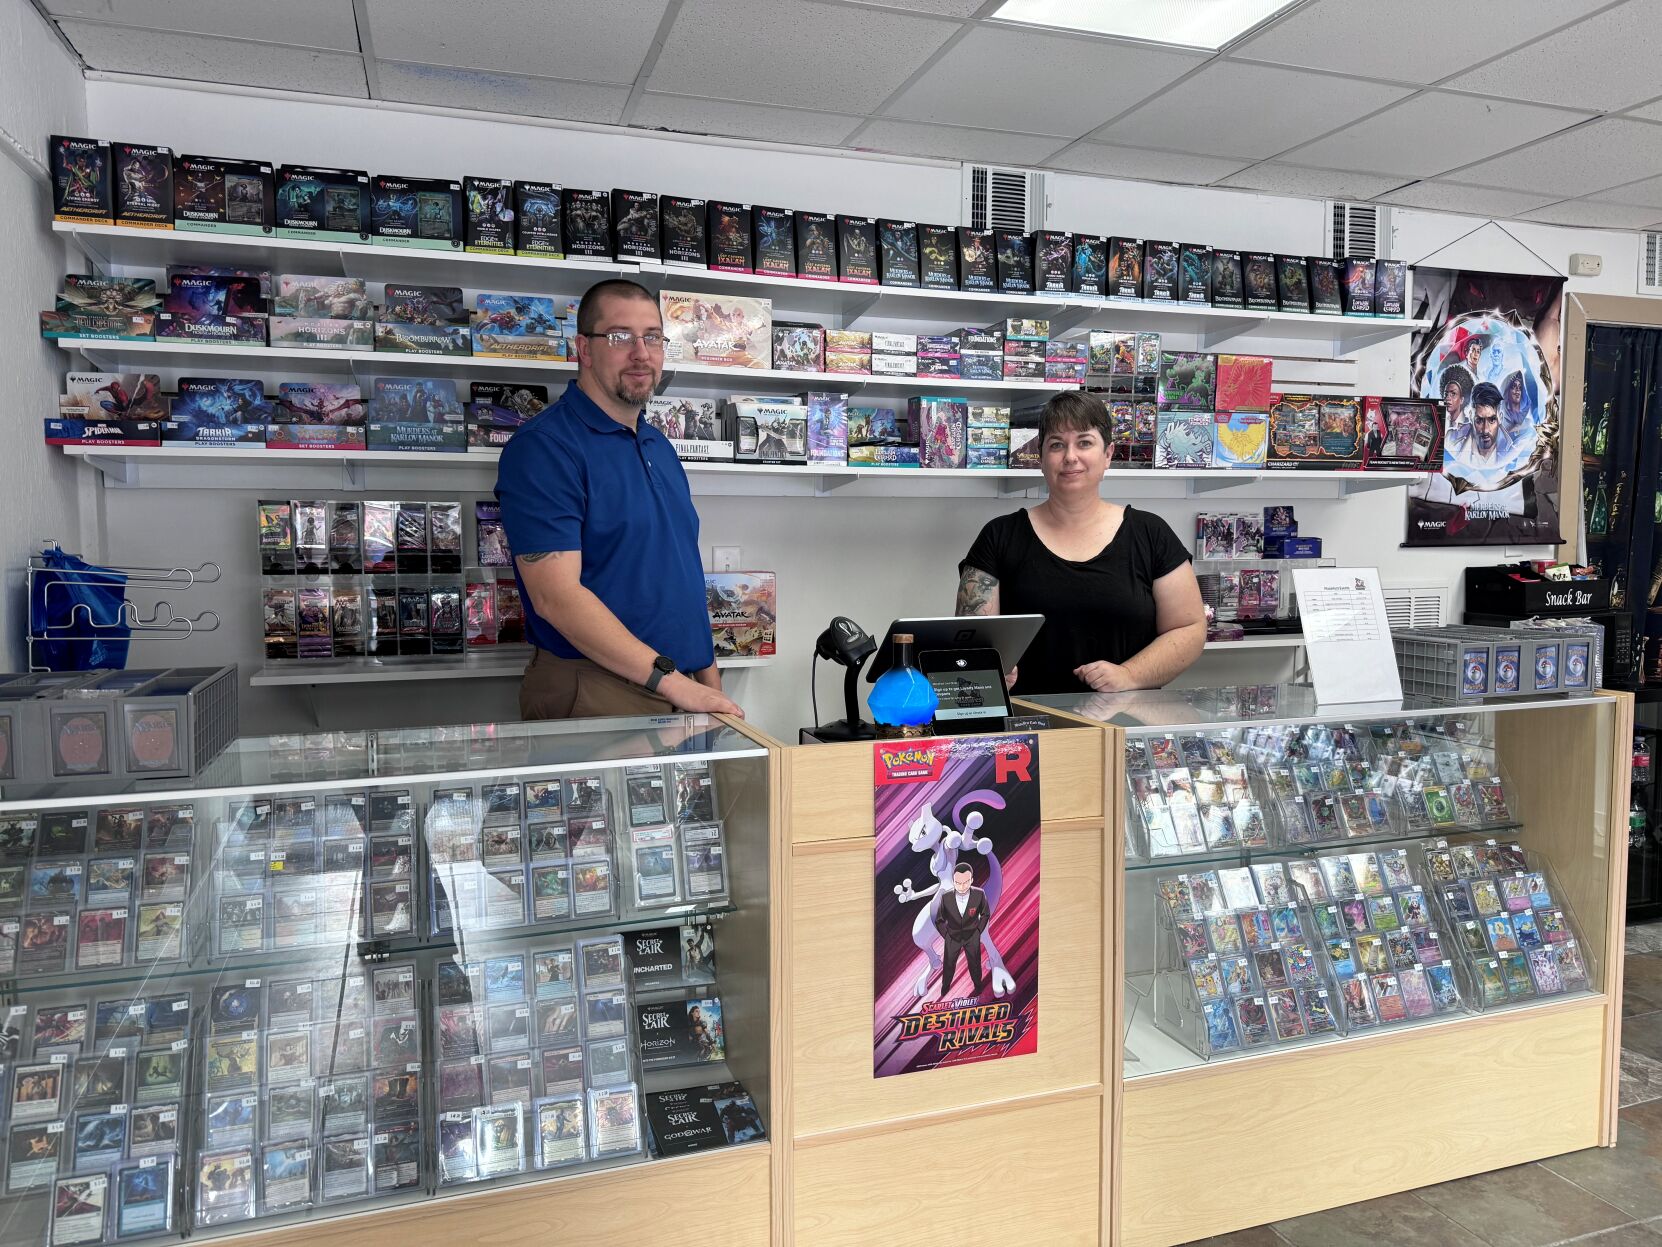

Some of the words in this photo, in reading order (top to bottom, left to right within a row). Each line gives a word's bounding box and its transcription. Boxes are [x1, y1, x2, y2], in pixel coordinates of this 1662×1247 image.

[70, 141, 97, 150] MAGIC
[131, 147, 158, 156] MAGIC
[190, 163, 215, 171] MAGIC
[284, 218, 318, 226] DUSKMOURN
[572, 243, 606, 251] HORIZONS
[624, 244, 654, 252] HORIZONS
[670, 250, 700, 258] HORIZONS
[77, 279, 109, 287] MAGIC
[182, 279, 212, 287] MAGIC
[394, 290, 422, 298] MAGIC
[186, 324, 237, 334] DUSKMOURN
[298, 326, 346, 335] HORIZONS
[396, 334, 451, 344] BLOOMBURROW
[490, 343, 548, 352] AETHERDRIFT
[693, 339, 736, 350] AVATAR
[77, 376, 103, 384] MAGIC
[288, 386, 317, 394] MAGIC
[814, 394, 831, 402] MAGIC
[763, 408, 788, 416] MAGIC
[196, 427, 233, 437] TARKIR
[396, 426, 431, 435] MURDERS
[390, 434, 418, 444] KARLOV
[418, 435, 444, 444] MANOR
[676, 444, 690, 453] FINAL
[691, 444, 710, 454] FANTASY
[810, 448, 846, 458] FOUNDATIONS
[1464, 510, 1488, 522] KARLOV
[1488, 510, 1511, 520] MANOR
[1424, 520, 1447, 528] MAGIC
[1545, 590, 1573, 609] Snack
[1575, 589, 1593, 608] Bar
[712, 610, 750, 622] AVATAR
[636, 938, 663, 950] SECRET
[638, 943, 664, 956] LAIR
[642, 1011, 670, 1026] SECRET
[645, 1017, 670, 1030] LAIR
[898, 1003, 1013, 1039] DESTINED
[938, 1021, 1017, 1051] RIVALS
[640, 1037, 676, 1050] HORIZON
[668, 1111, 698, 1124] SECRET
[672, 1114, 701, 1126] LAIR
[664, 1132, 684, 1141] GOD
[692, 1126, 712, 1137] WAR
